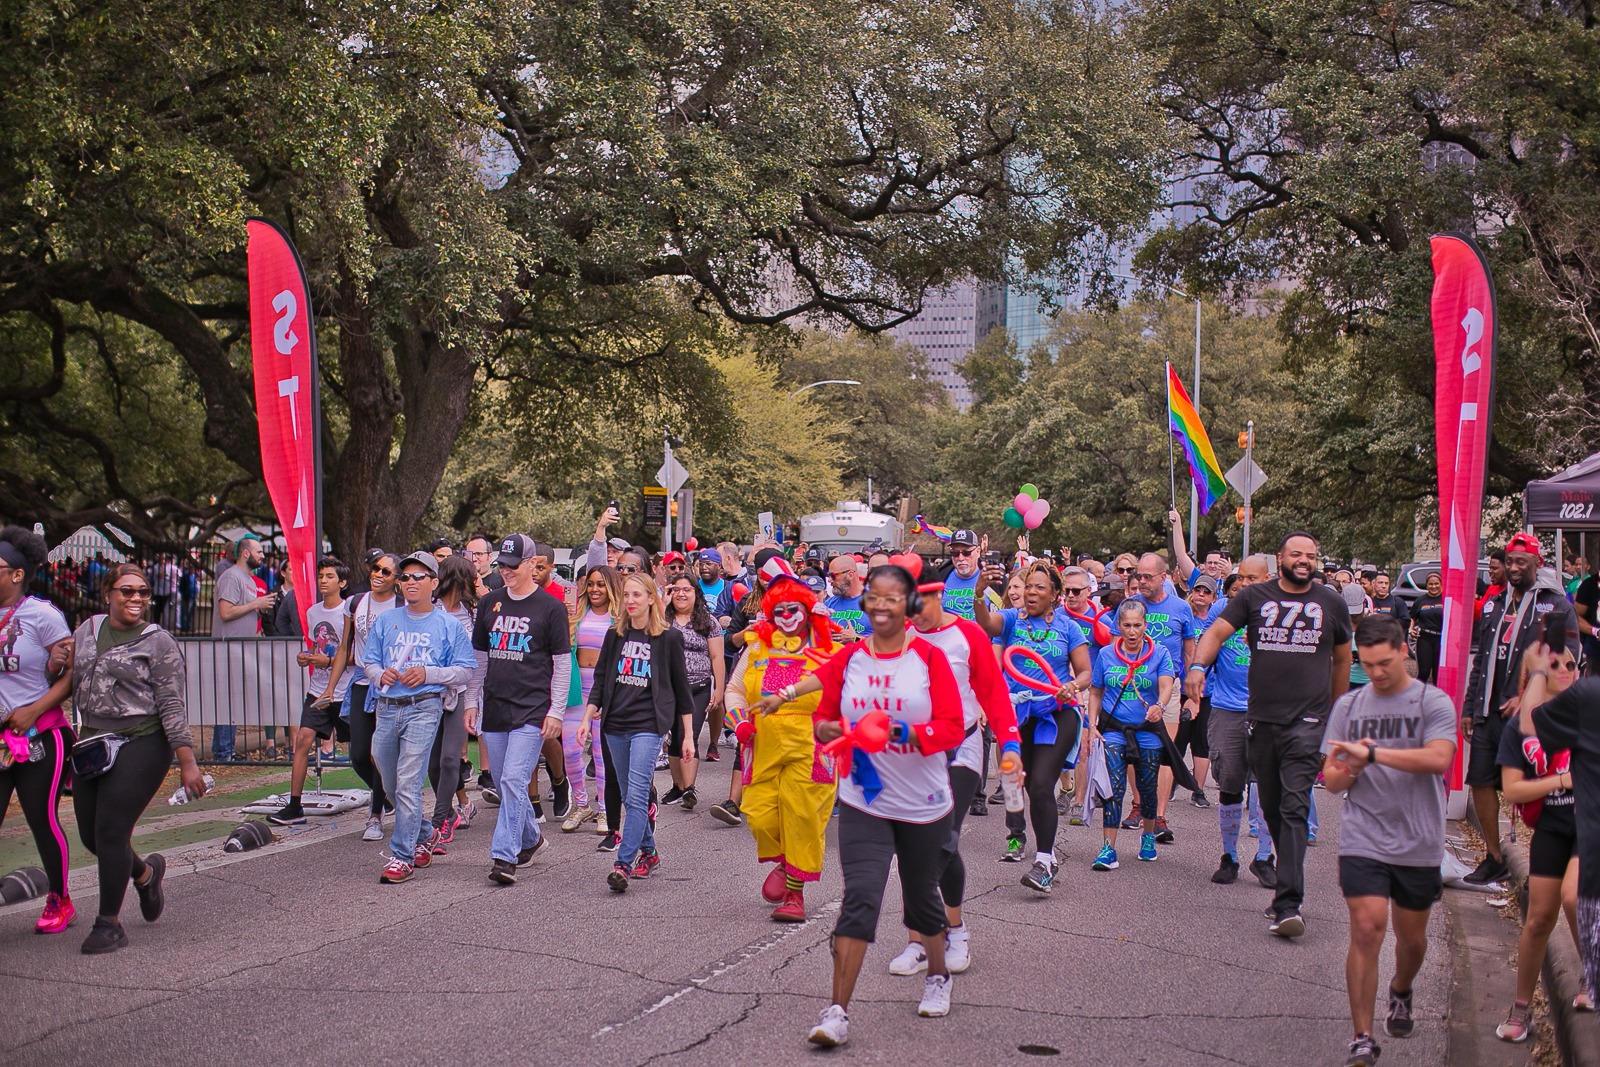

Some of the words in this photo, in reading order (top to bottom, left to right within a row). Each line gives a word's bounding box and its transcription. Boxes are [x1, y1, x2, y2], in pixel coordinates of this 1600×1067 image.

[1560, 503, 1594, 519] 102.1
[1260, 601, 1324, 629] 97.9
[492, 615, 531, 633] AIDS
[394, 631, 431, 647] AIDS
[489, 631, 533, 653] WALK
[1258, 627, 1289, 643] THE
[1291, 629, 1322, 644] BOX
[388, 646, 434, 663] WLK
[621, 640, 651, 660] AIDS
[868, 674, 896, 689] WE
[851, 696, 911, 713] WALK
[1348, 716, 1422, 742] ARMY
